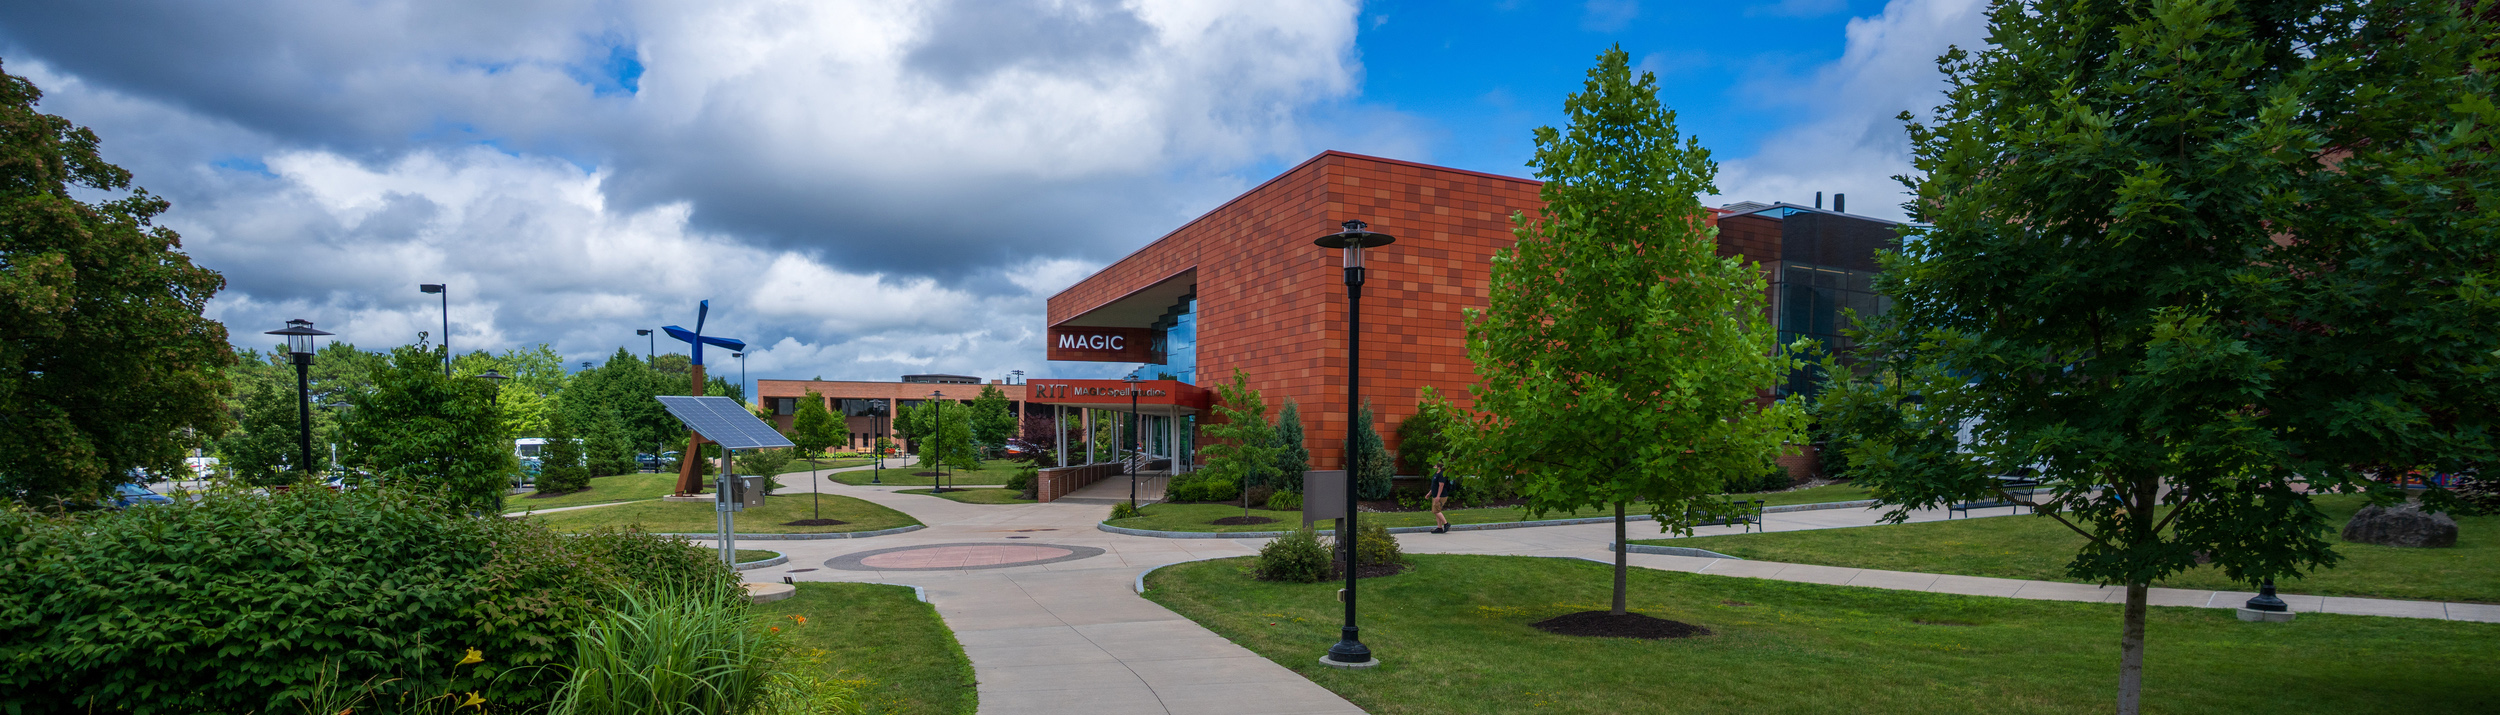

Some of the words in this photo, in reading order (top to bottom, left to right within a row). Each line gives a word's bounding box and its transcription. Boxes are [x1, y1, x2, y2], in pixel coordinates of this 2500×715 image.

[1058, 334, 1124, 350] MAGIC
[1035, 383, 1069, 399] RIT
[1074, 386, 1106, 396] MAGIC
[1107, 387, 1130, 398] Spell
[1132, 387, 1167, 397] tudios
